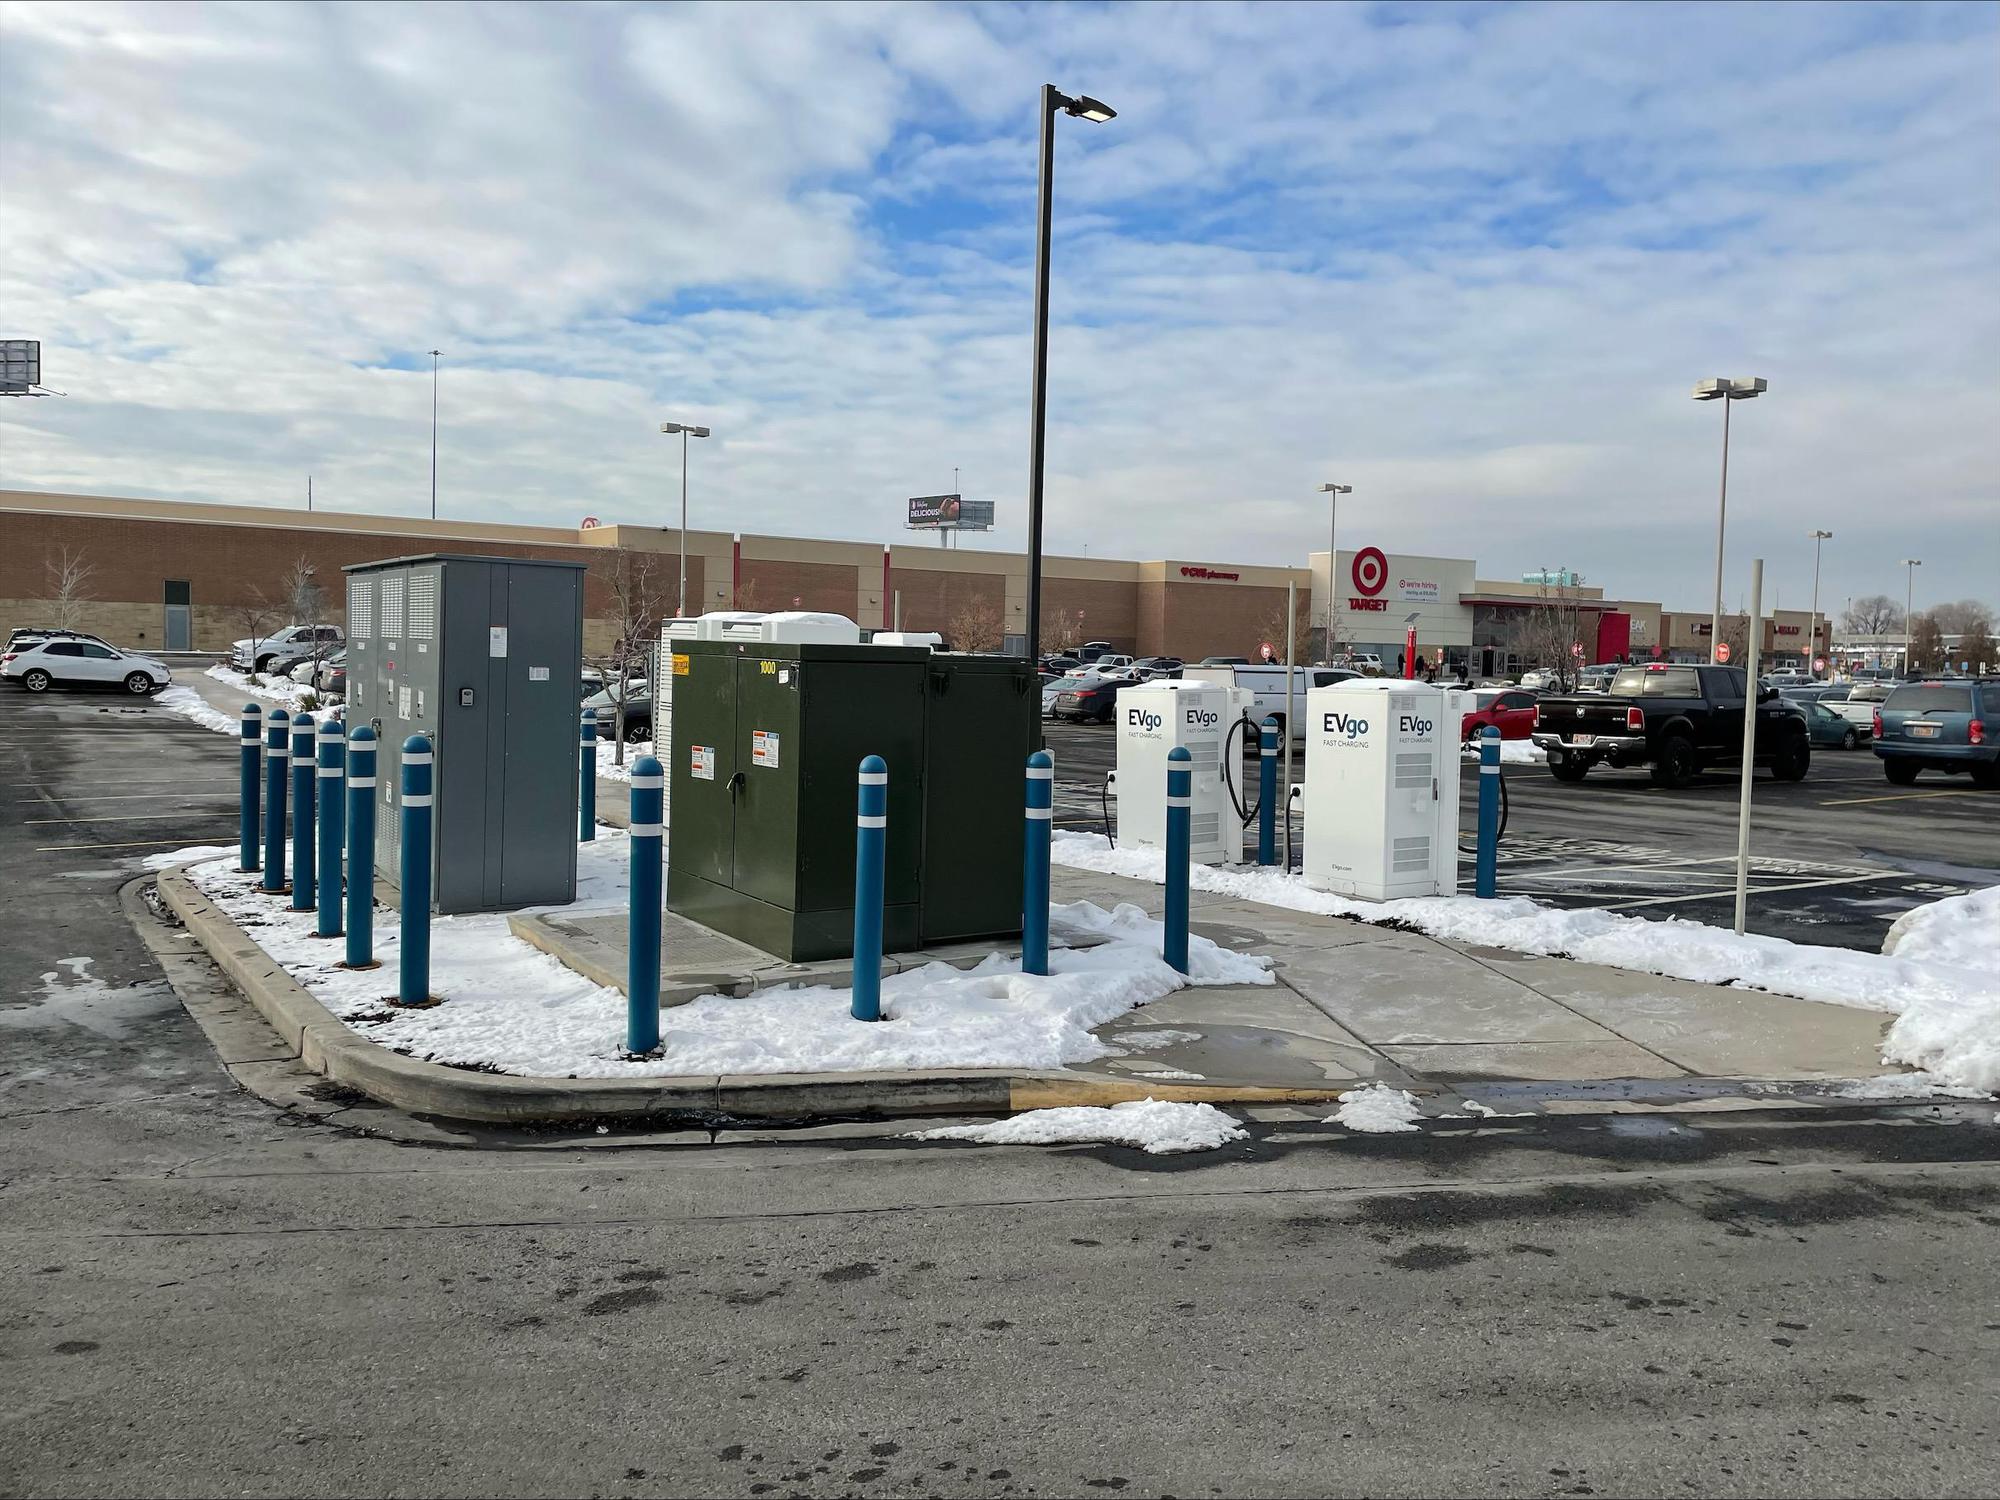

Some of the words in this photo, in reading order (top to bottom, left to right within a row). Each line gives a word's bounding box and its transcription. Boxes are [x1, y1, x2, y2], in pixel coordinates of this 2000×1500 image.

[1207, 570, 1240, 582] pharmacy
[1348, 598, 1389, 611] TARGET
[760, 660, 776, 675] 1000
[1128, 709, 1162, 731] EVgo
[1187, 709, 1218, 727] EVgo
[1323, 713, 1369, 739] EVgo
[1400, 716, 1433, 736] EVgo
[1128, 731, 1139, 739] FAST
[1139, 732, 1162, 740] CHARGING
[1323, 739, 1337, 747] FAST
[1337, 740, 1369, 749] CHARGING
